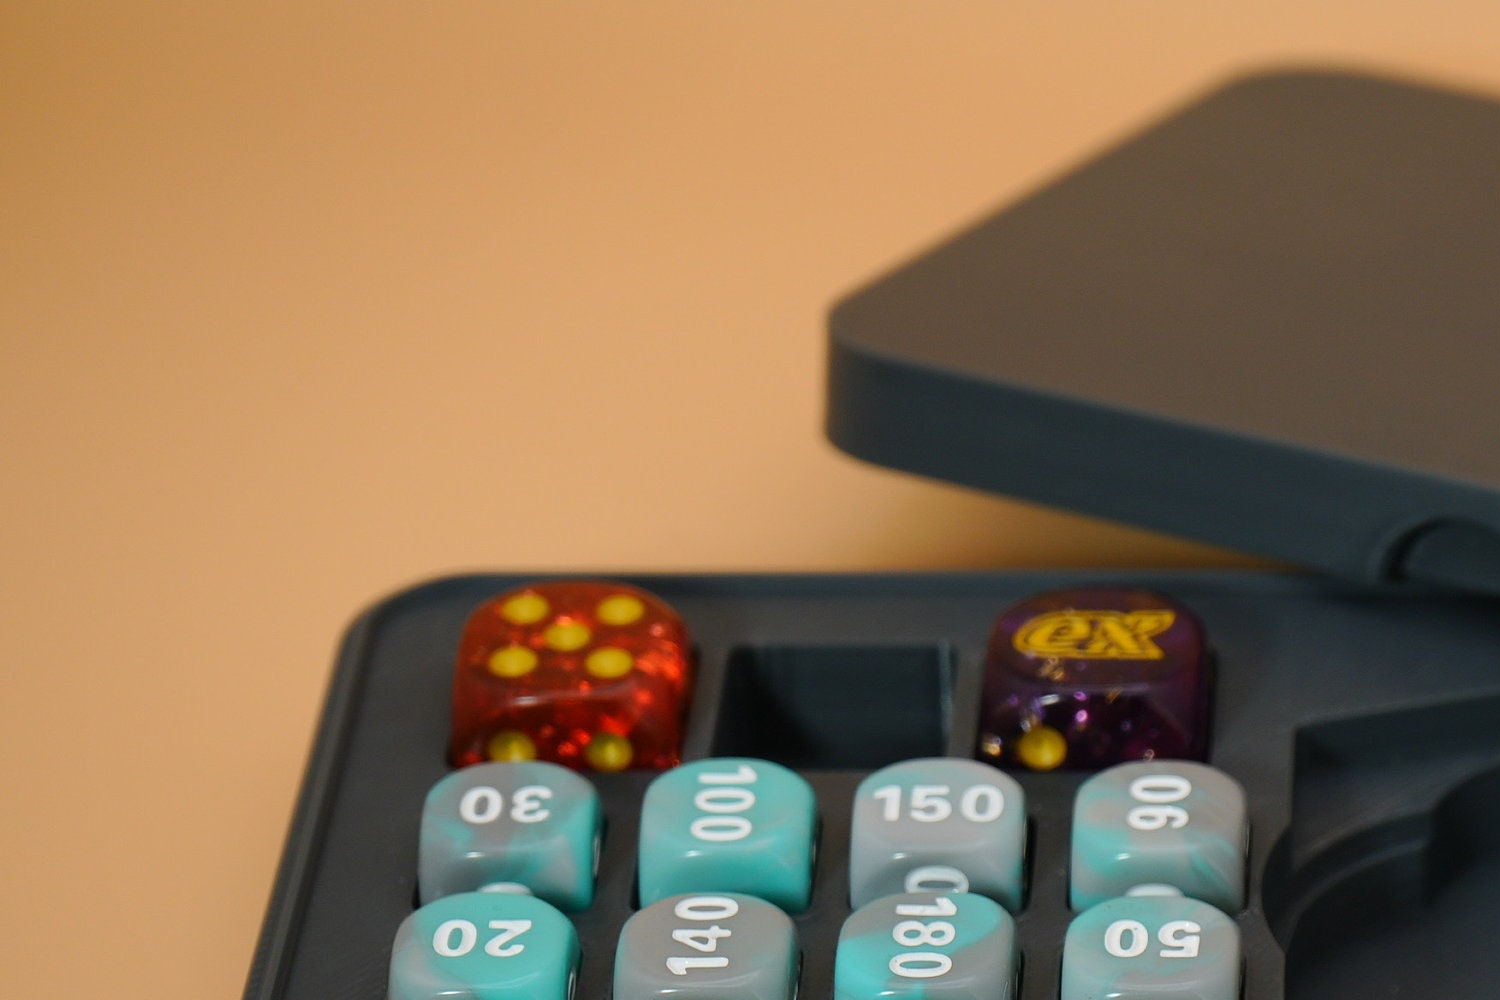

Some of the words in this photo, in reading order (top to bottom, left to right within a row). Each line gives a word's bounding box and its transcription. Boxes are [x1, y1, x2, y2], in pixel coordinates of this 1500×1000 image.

[1012, 609, 1176, 660] ex
[459, 785, 553, 824] 30
[690, 765, 758, 842] 100
[873, 784, 1005, 823] 150
[432, 919, 533, 957] 20
[665, 896, 739, 976] 140
[888, 896, 957, 979] 180
[1103, 919, 1202, 959] 50
